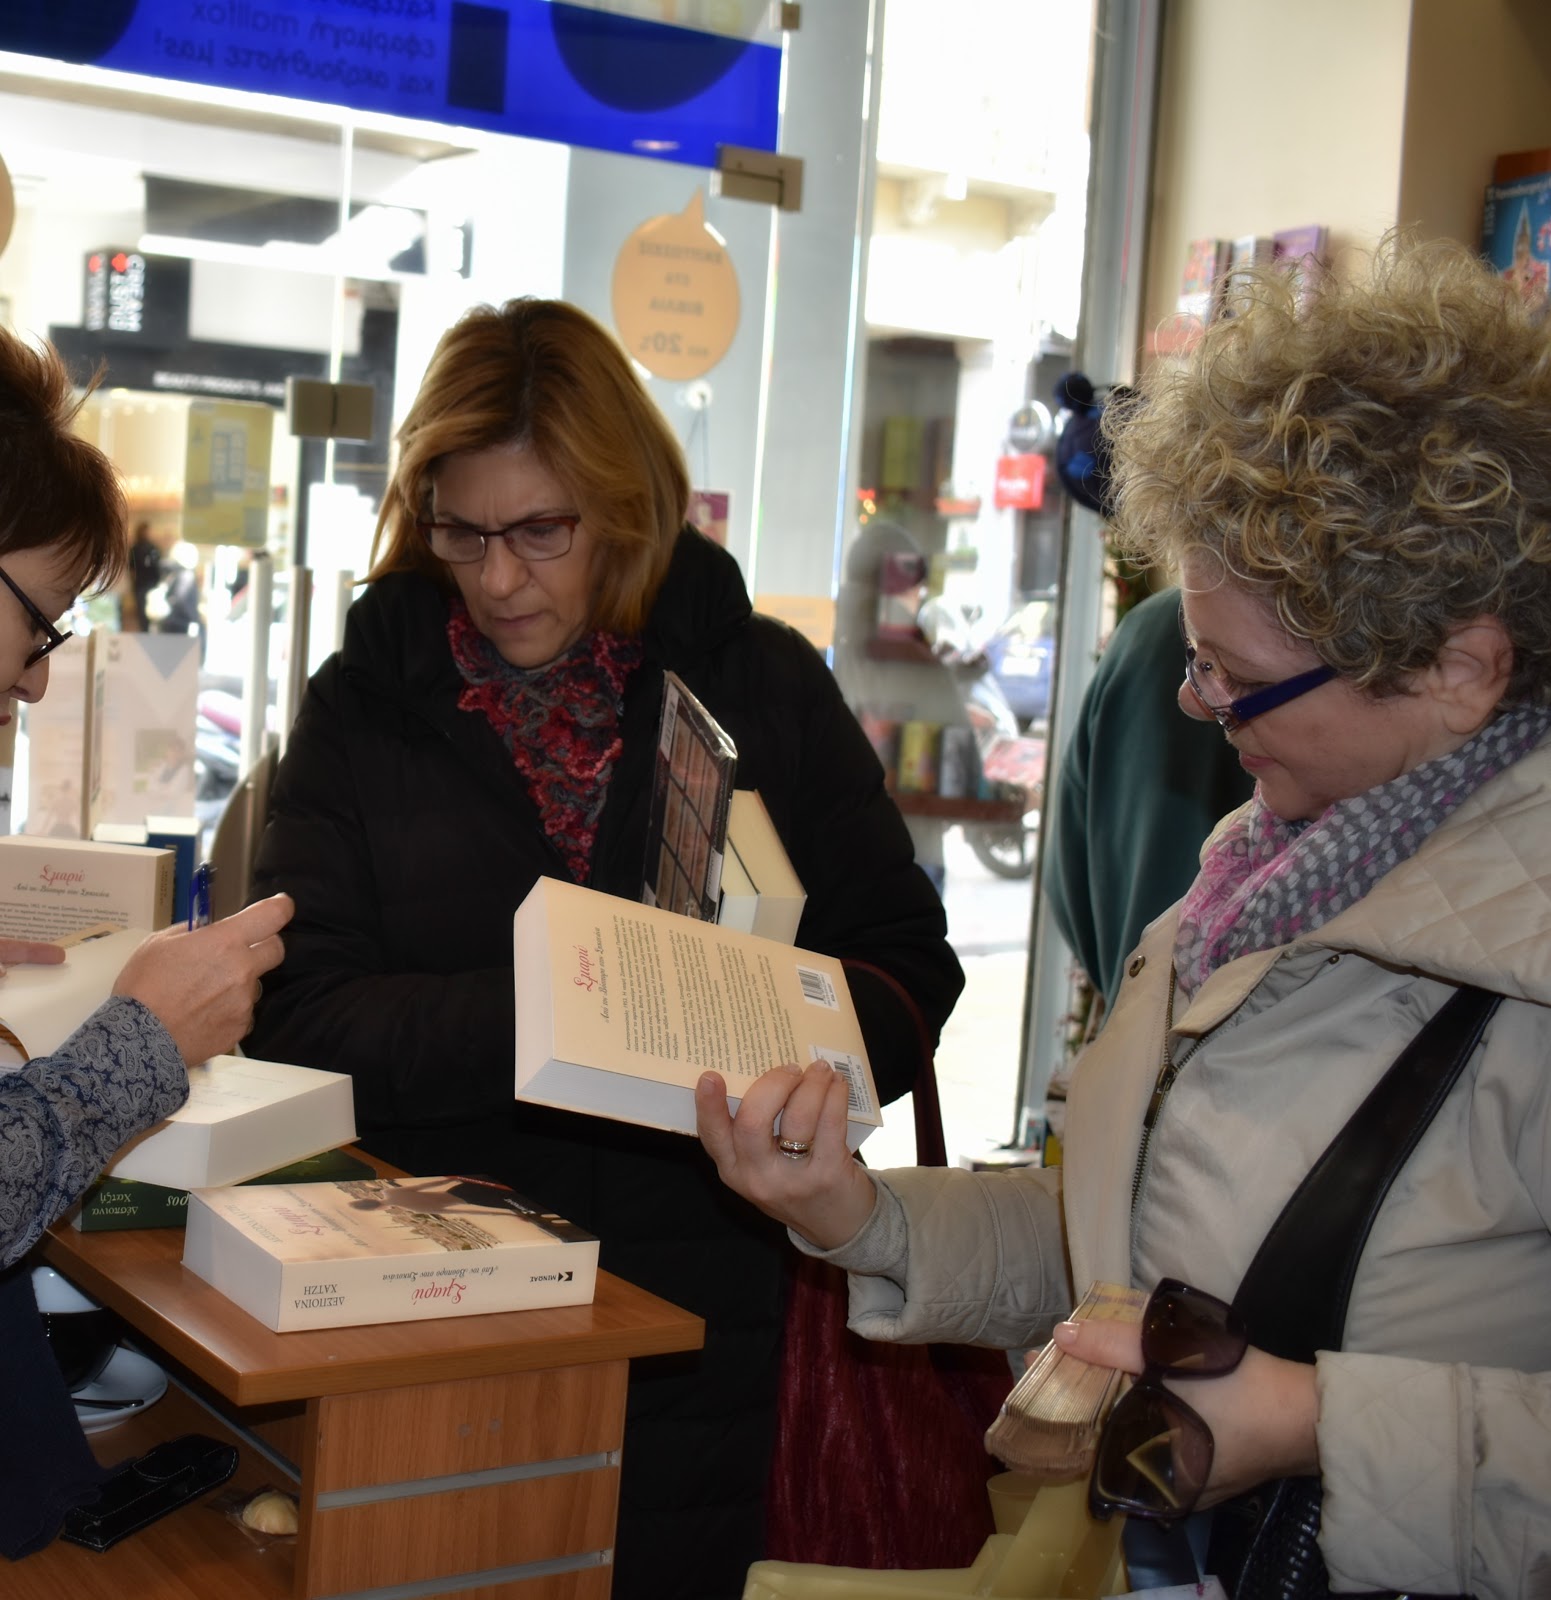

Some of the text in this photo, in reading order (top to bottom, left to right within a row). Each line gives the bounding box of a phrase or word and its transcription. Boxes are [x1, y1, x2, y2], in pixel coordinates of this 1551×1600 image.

[40, 864, 85, 886] Σμαρώ
[572, 944, 598, 992] Σμαρώ
[100, 1192, 131, 1204] Χατζή
[92, 1206, 138, 1216] Δέσποινα
[435, 1266, 466, 1278] Βόσπορο
[530, 1275, 557, 1283] ΜΙΝΩΑΣ
[303, 1284, 338, 1295] ΧΑΤΖΗ
[411, 1278, 467, 1306] Σμαρώ
[294, 1296, 345, 1309] ΔΕΣΠΟΙΝΑ
